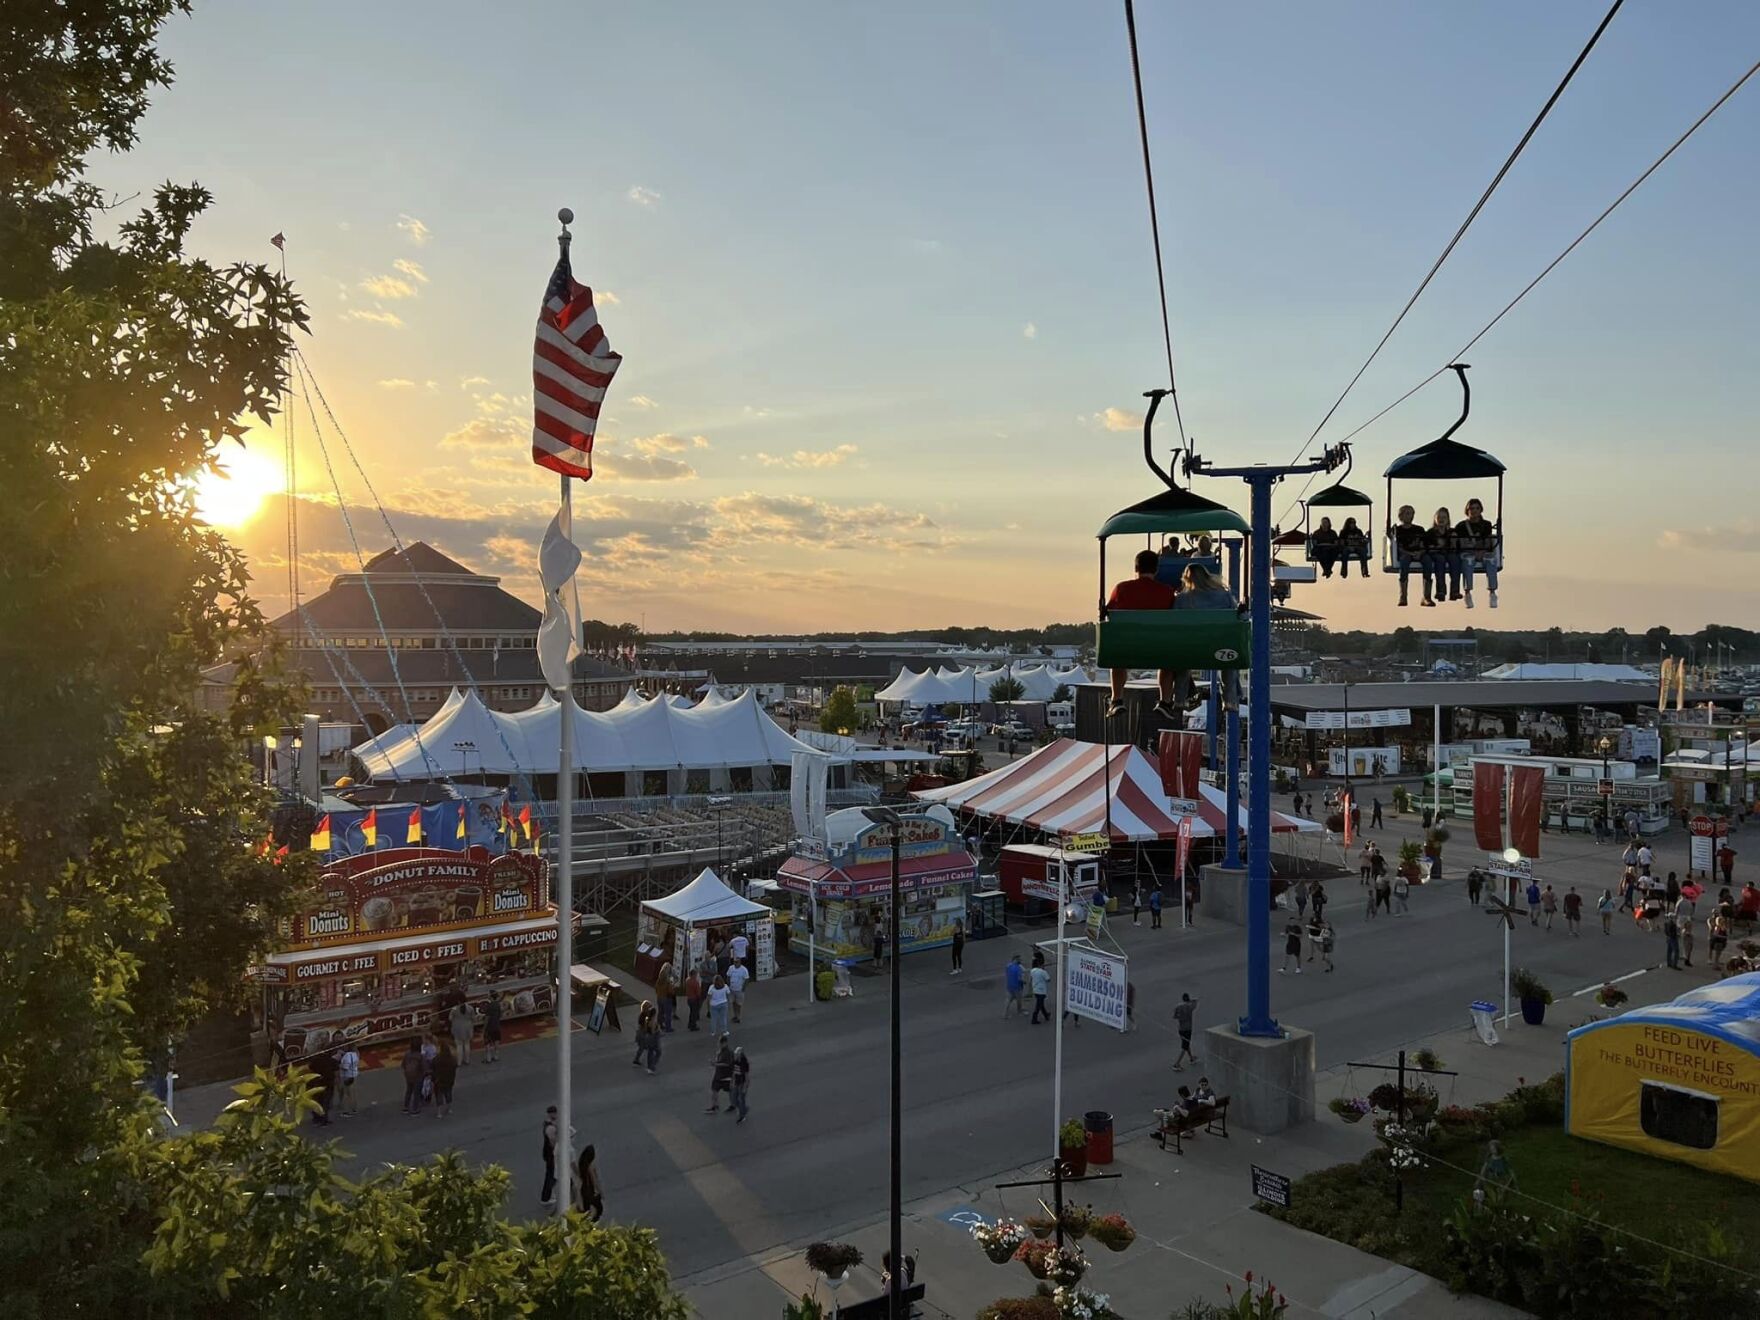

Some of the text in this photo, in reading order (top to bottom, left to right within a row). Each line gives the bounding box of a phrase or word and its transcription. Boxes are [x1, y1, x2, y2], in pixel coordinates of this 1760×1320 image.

[1219, 650, 1235, 660] 76
[1692, 822, 1712, 831] STOP
[373, 866, 425, 887] DONUT
[428, 865, 479, 877] FAMILY
[869, 879, 915, 893] Lemoade
[921, 870, 974, 885] Funnel Cakes
[328, 890, 345, 898] HOT
[494, 892, 528, 911] Donuts
[502, 888, 520, 897] Mini
[318, 910, 340, 918] Mini
[309, 915, 349, 935] Donuts
[480, 929, 558, 951] HT CAPPUCCINO
[392, 943, 465, 964] ICED CFFEE
[297, 956, 376, 978] GOURMET CFFEE
[1080, 963, 1096, 972] STATE
[1069, 970, 1124, 1001] EMMERSON
[1069, 988, 1123, 1018] BUILDING
[1643, 1026, 1721, 1055] FEED LIVE
[1635, 1043, 1736, 1076] BUTTERFLIES
[1600, 1049, 1760, 1095] THE BUTTERFLY ENCOUNT
